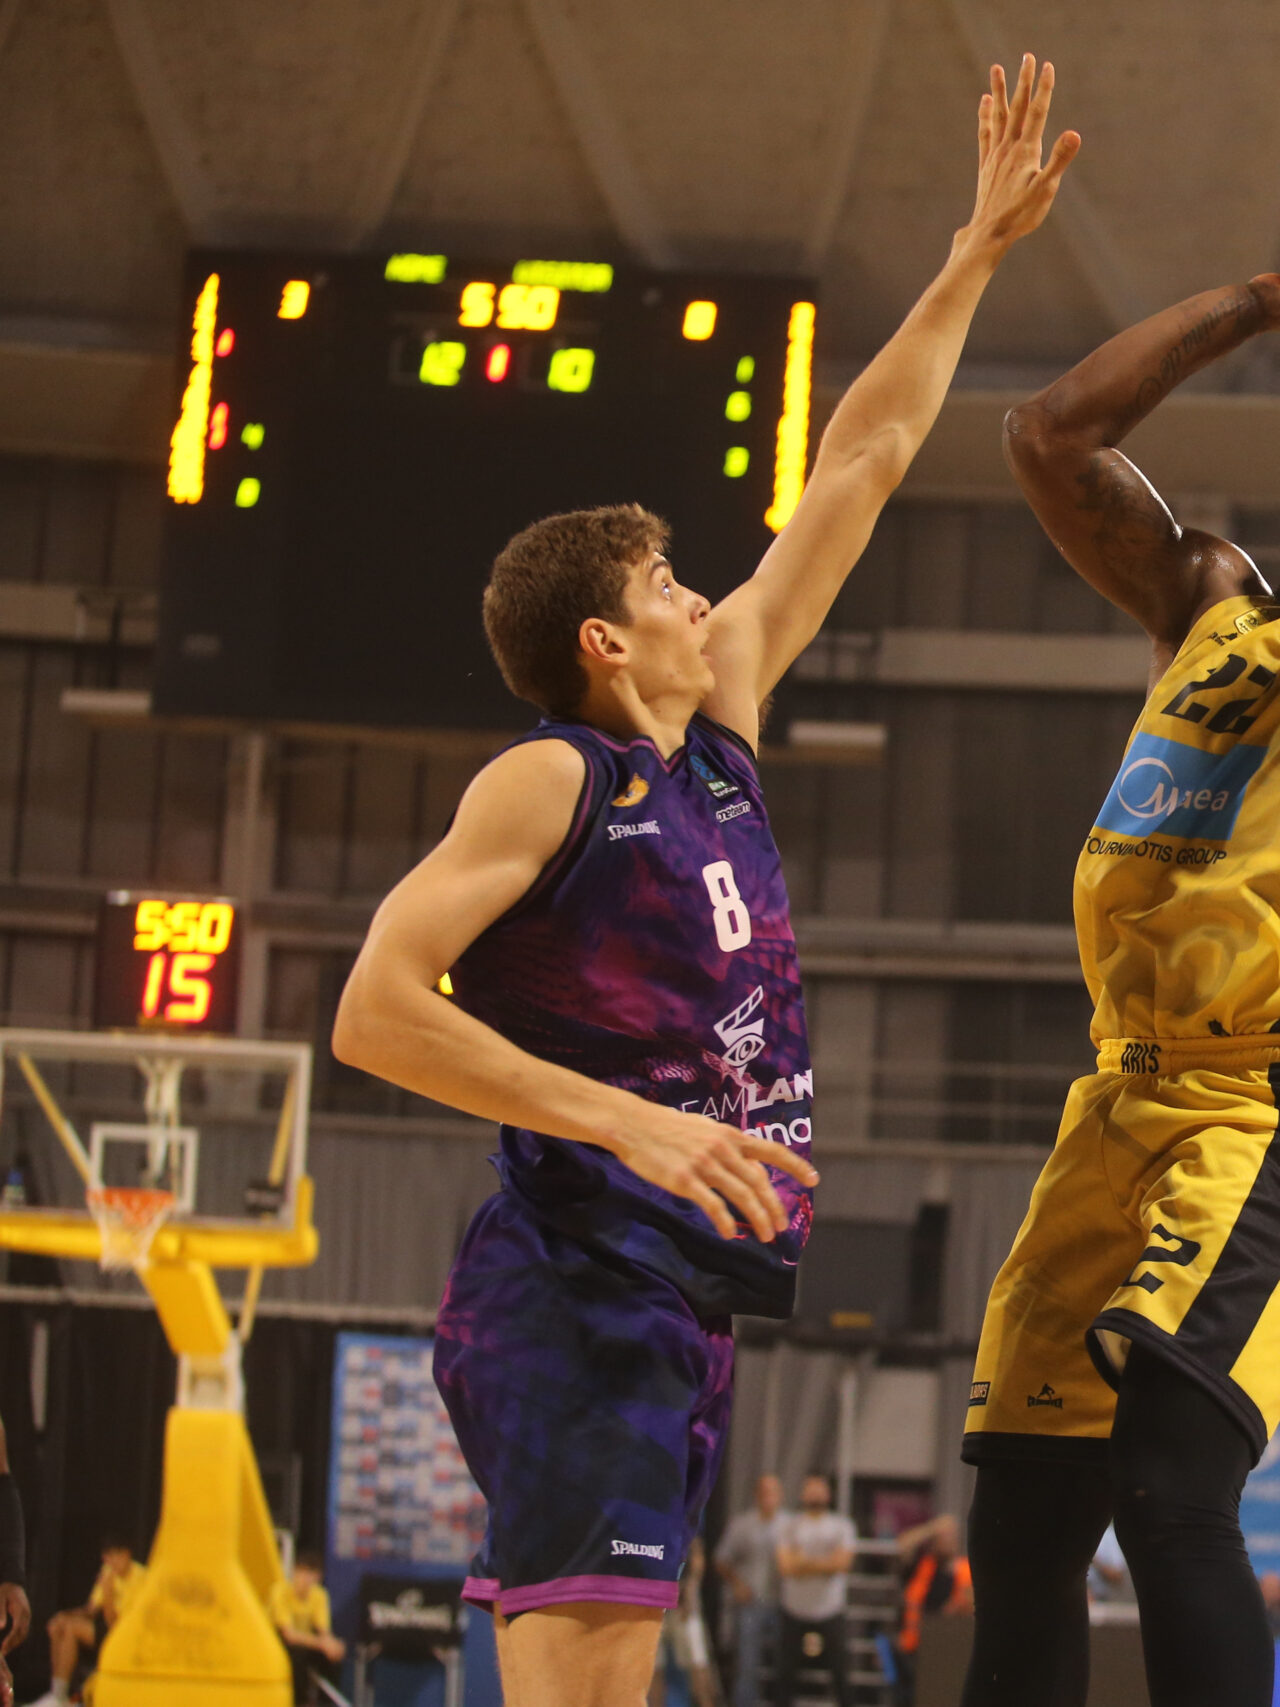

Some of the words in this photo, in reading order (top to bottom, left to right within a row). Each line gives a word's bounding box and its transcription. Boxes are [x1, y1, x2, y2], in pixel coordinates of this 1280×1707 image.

[607, 819, 661, 841] SPALDING
[1176, 847, 1228, 864] GROUP
[702, 861, 751, 952] 8
[142, 952, 216, 1023] 15
[1121, 1042, 1162, 1074] ARIS
[611, 1539, 664, 1560] SPALDING
